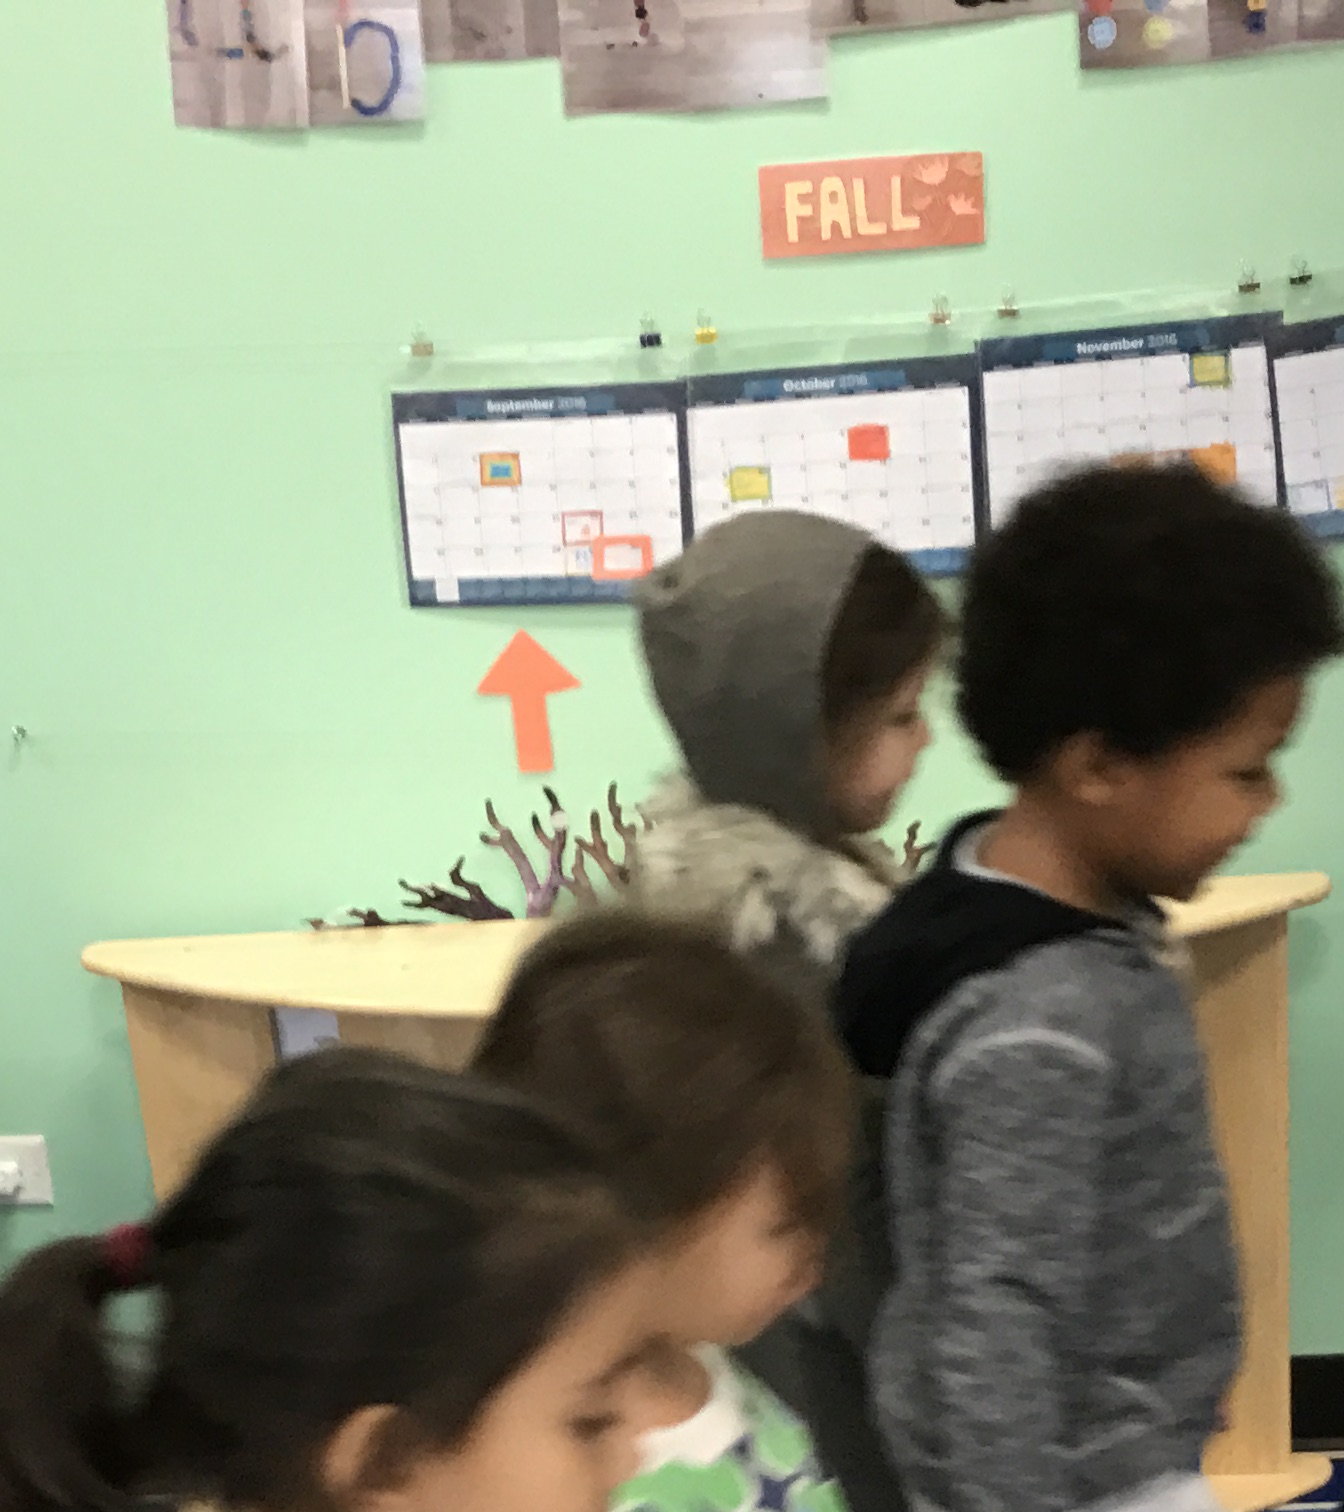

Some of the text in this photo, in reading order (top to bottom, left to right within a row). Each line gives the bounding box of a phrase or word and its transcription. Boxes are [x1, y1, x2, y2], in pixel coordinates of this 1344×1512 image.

[785, 176, 920, 243] FALL
[1076, 337, 1144, 354] November
[783, 376, 836, 393] October
[486, 397, 554, 414] September
